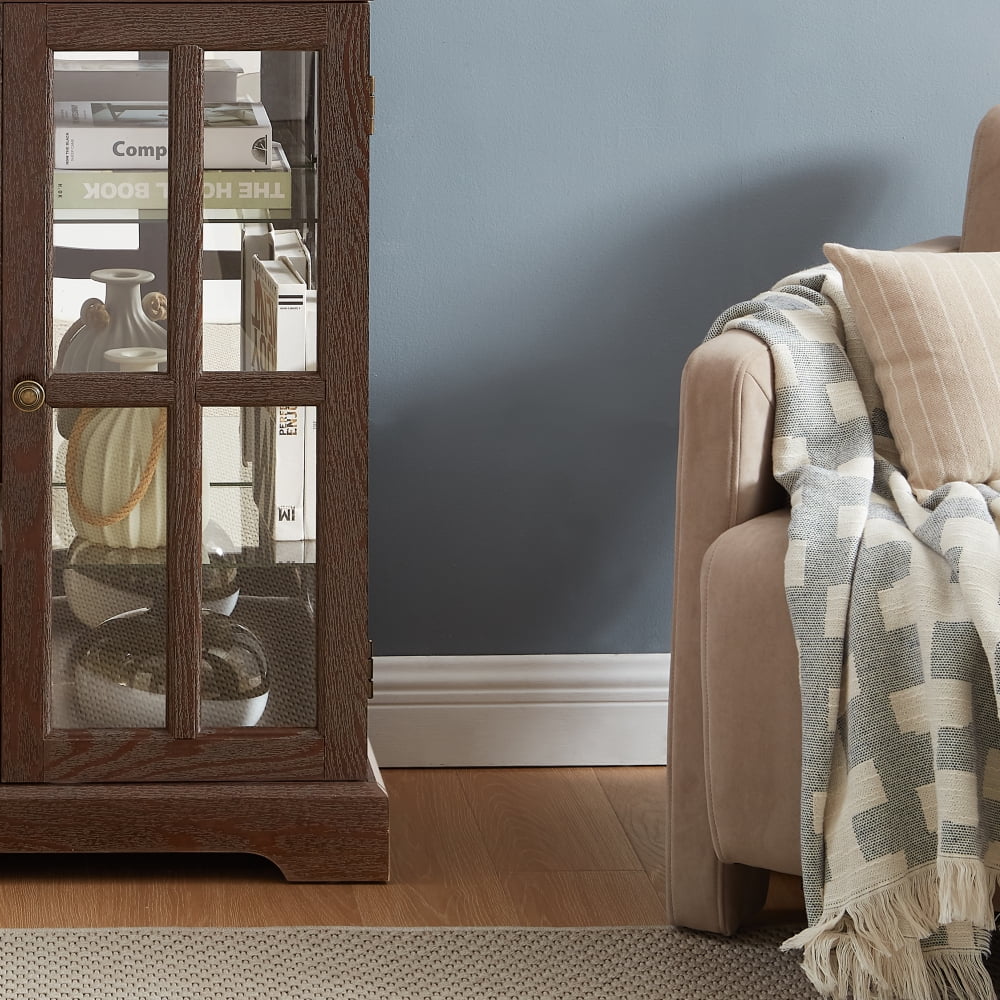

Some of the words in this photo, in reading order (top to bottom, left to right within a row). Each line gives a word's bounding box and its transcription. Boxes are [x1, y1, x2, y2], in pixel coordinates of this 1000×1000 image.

[112, 140, 168, 161] Comp
[83, 182, 150, 200] BOOK
[239, 182, 285, 199] THE
